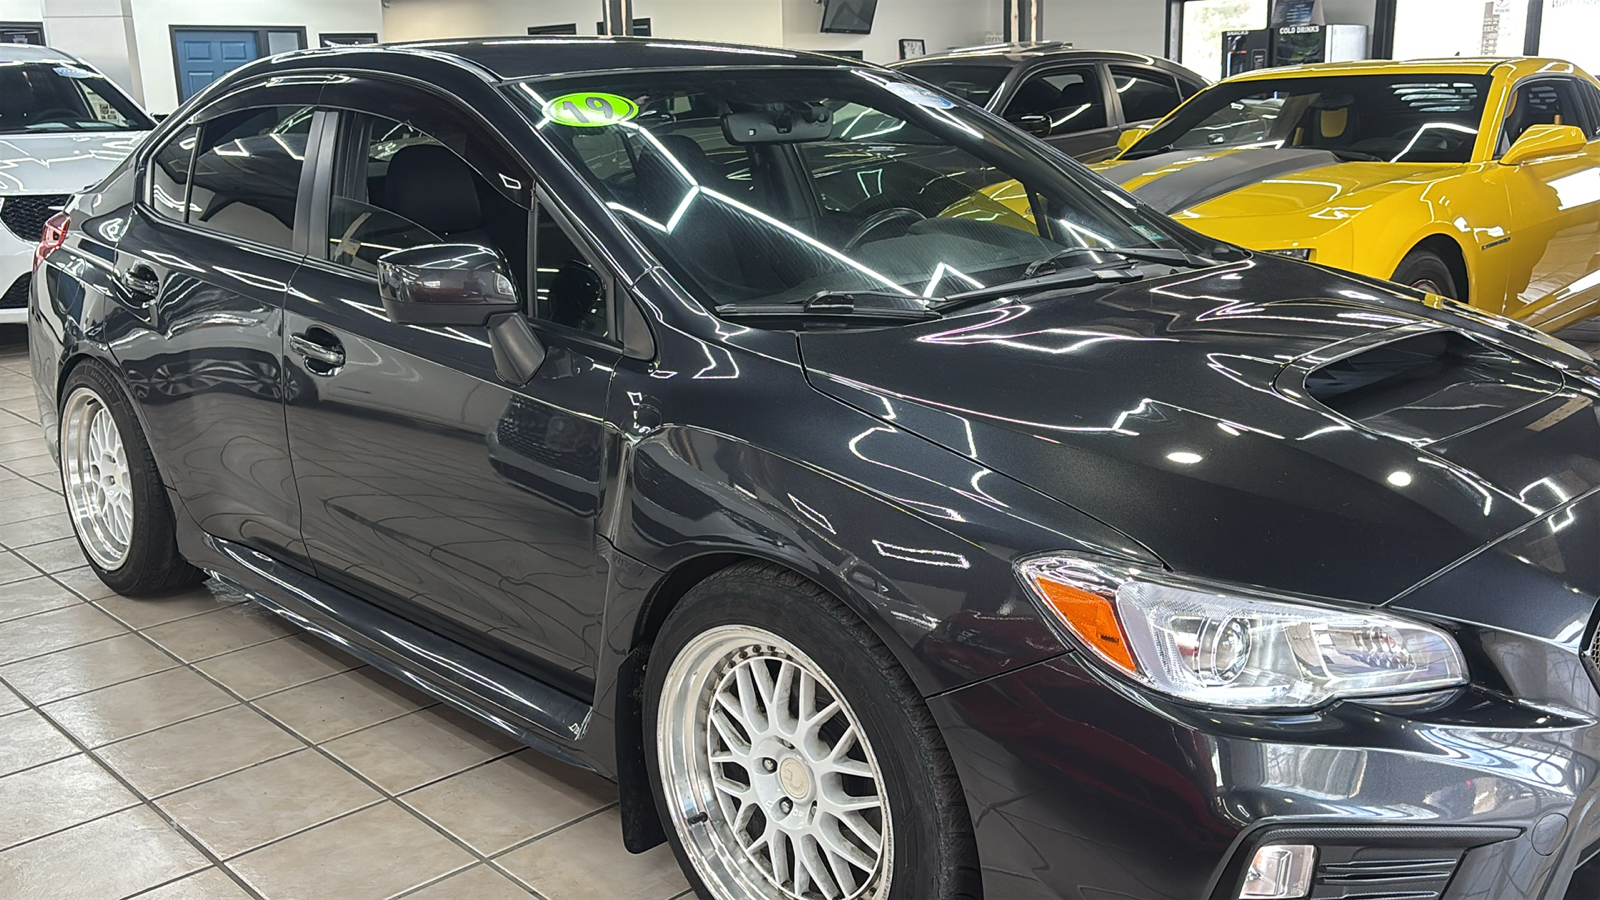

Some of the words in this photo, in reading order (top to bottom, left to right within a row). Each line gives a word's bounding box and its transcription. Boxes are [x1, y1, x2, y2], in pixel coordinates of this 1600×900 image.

[1279, 26, 1296, 35] COLD
[1296, 25, 1320, 34] DRINKS
[563, 97, 613, 123] 19
